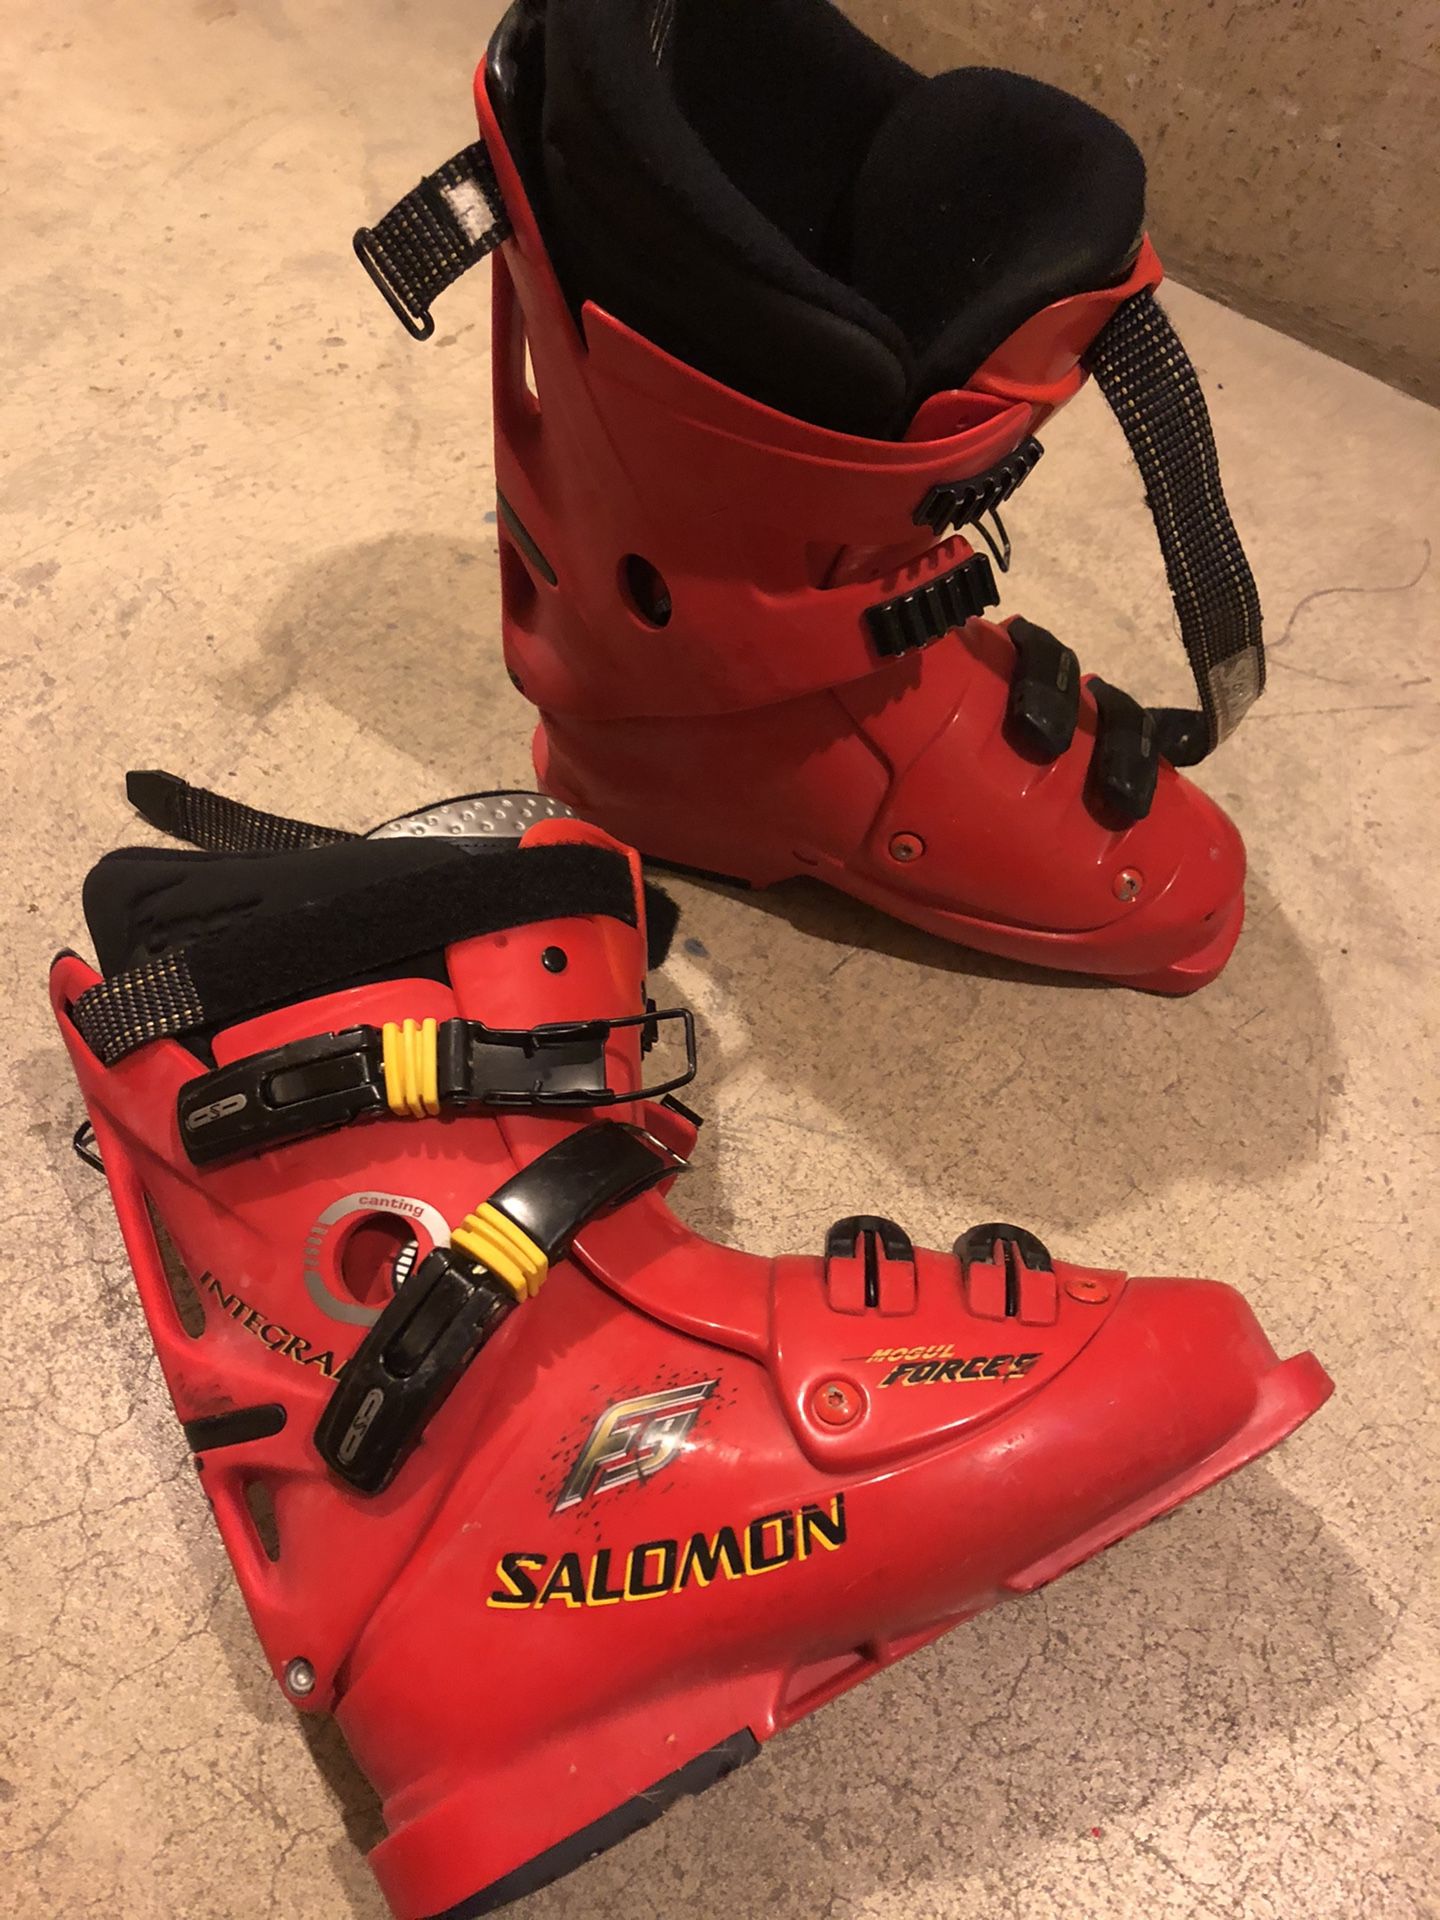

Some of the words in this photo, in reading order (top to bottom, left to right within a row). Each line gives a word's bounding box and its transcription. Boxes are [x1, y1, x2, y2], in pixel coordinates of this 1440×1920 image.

[358, 1196, 425, 1217] canting
[866, 1344, 955, 1363] MOGUL
[486, 1492, 848, 1609] SALOMON
